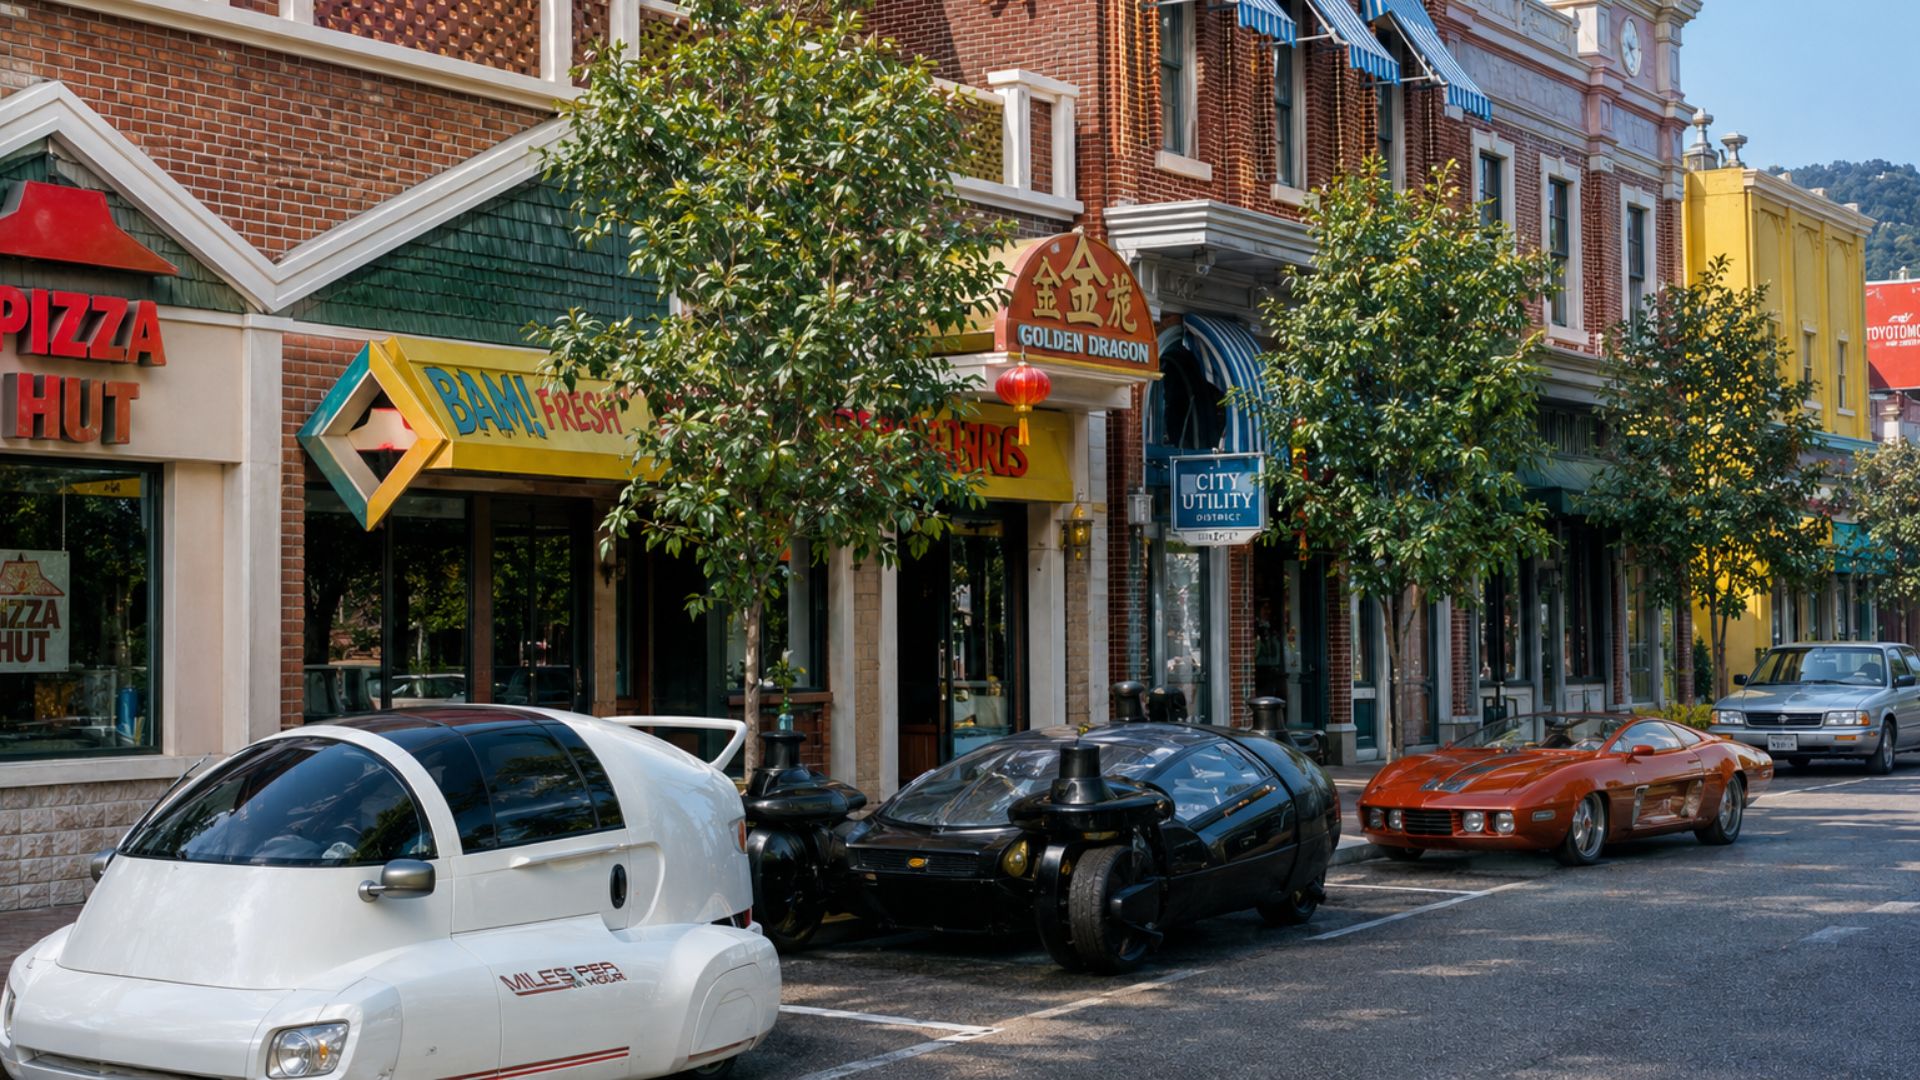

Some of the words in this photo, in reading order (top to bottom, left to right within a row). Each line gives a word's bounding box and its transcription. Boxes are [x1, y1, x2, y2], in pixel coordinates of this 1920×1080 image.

[0, 285, 167, 366] PIZZA
[1019, 325, 1084, 353] GOLDEN
[1088, 335, 1149, 363] DRAGON
[15, 372, 140, 445] HUT
[424, 366, 547, 438] BAM!
[536, 387, 623, 434] FRESH
[1196, 473, 1241, 490] CITY
[1182, 493, 1253, 510] UTILITY
[1196, 513, 1241, 522] DISTRICT
[0, 599, 61, 629] IZZA
[0, 631, 50, 663] HUT
[499, 967, 577, 991] MILES
